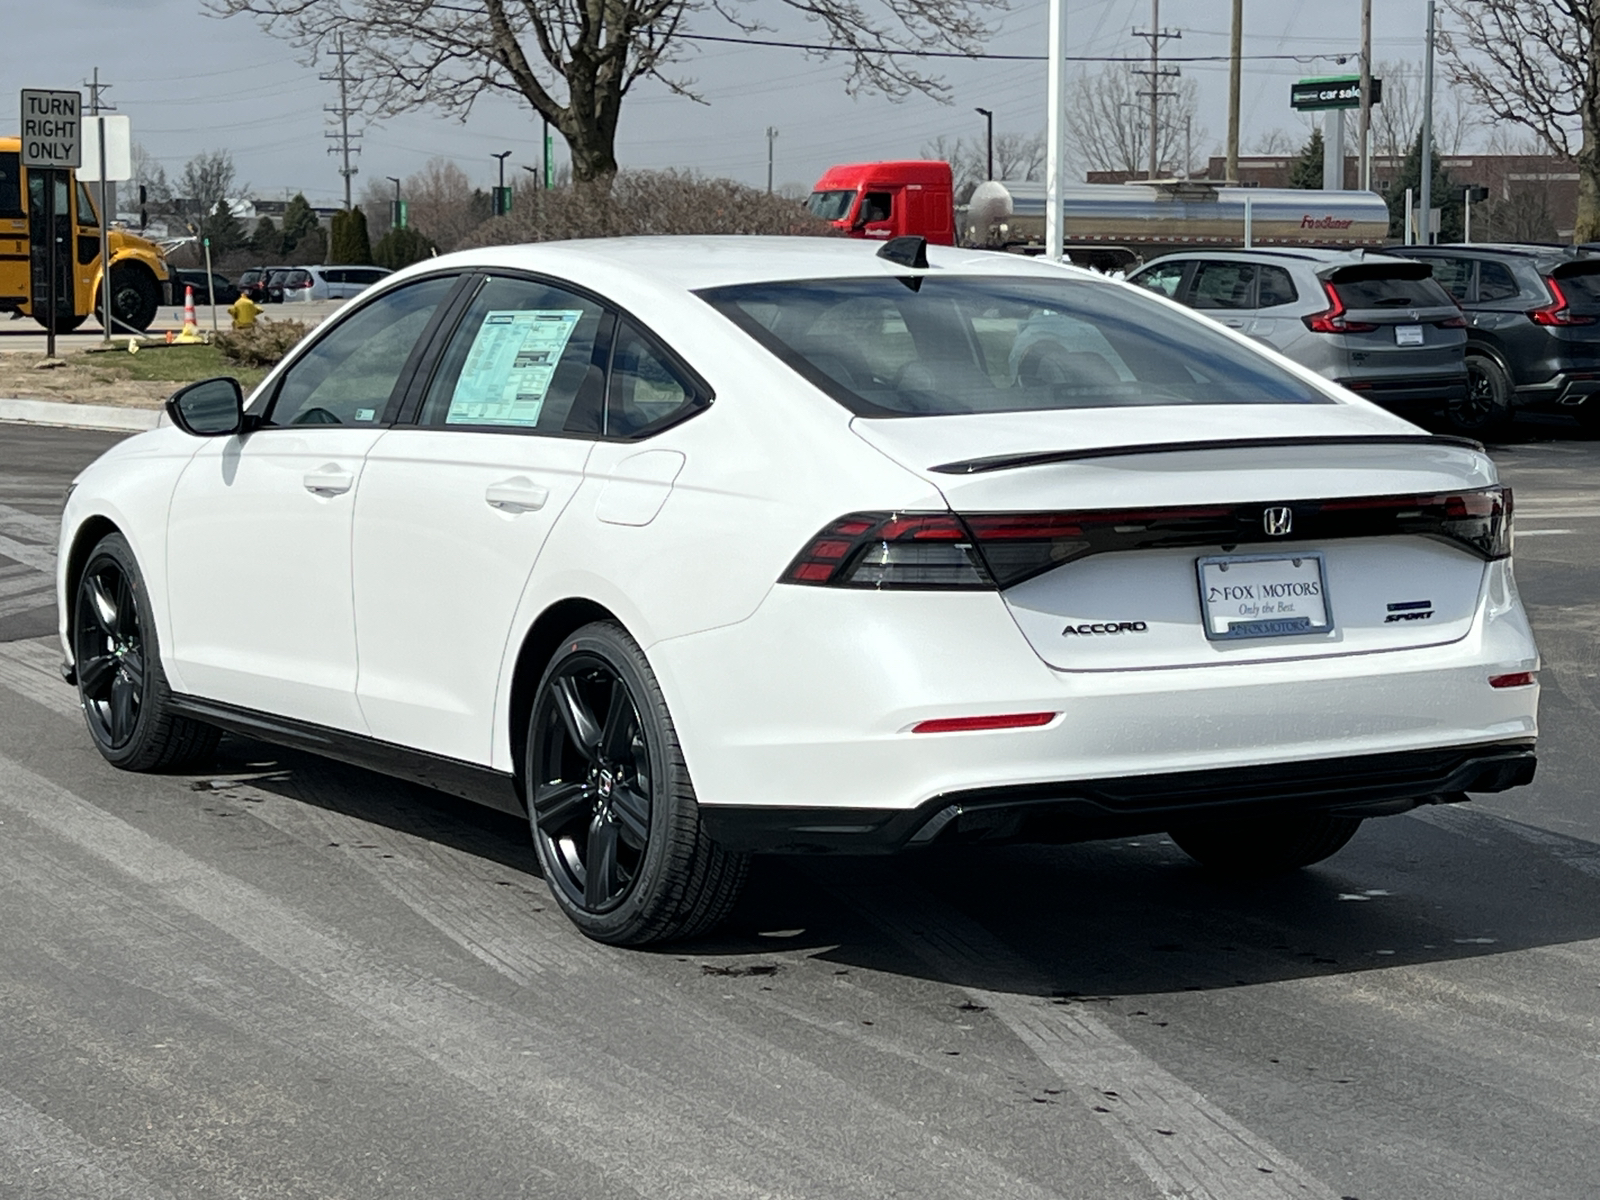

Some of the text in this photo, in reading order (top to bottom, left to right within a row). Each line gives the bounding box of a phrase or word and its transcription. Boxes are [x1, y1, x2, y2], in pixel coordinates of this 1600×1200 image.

[1319, 89, 1338, 100] car
[1339, 85, 1361, 98] sale
[28, 96, 75, 116] TURN
[25, 119, 77, 138] RIGHT
[28, 141, 74, 161] ONLY
[1223, 581, 1319, 601] FOX MOTORS
[1238, 602, 1260, 618] Only
[1261, 601, 1275, 614] the
[1384, 610, 1435, 623] SPORT
[1061, 621, 1147, 637] ACCORD
[1264, 619, 1305, 634] MOTORS
